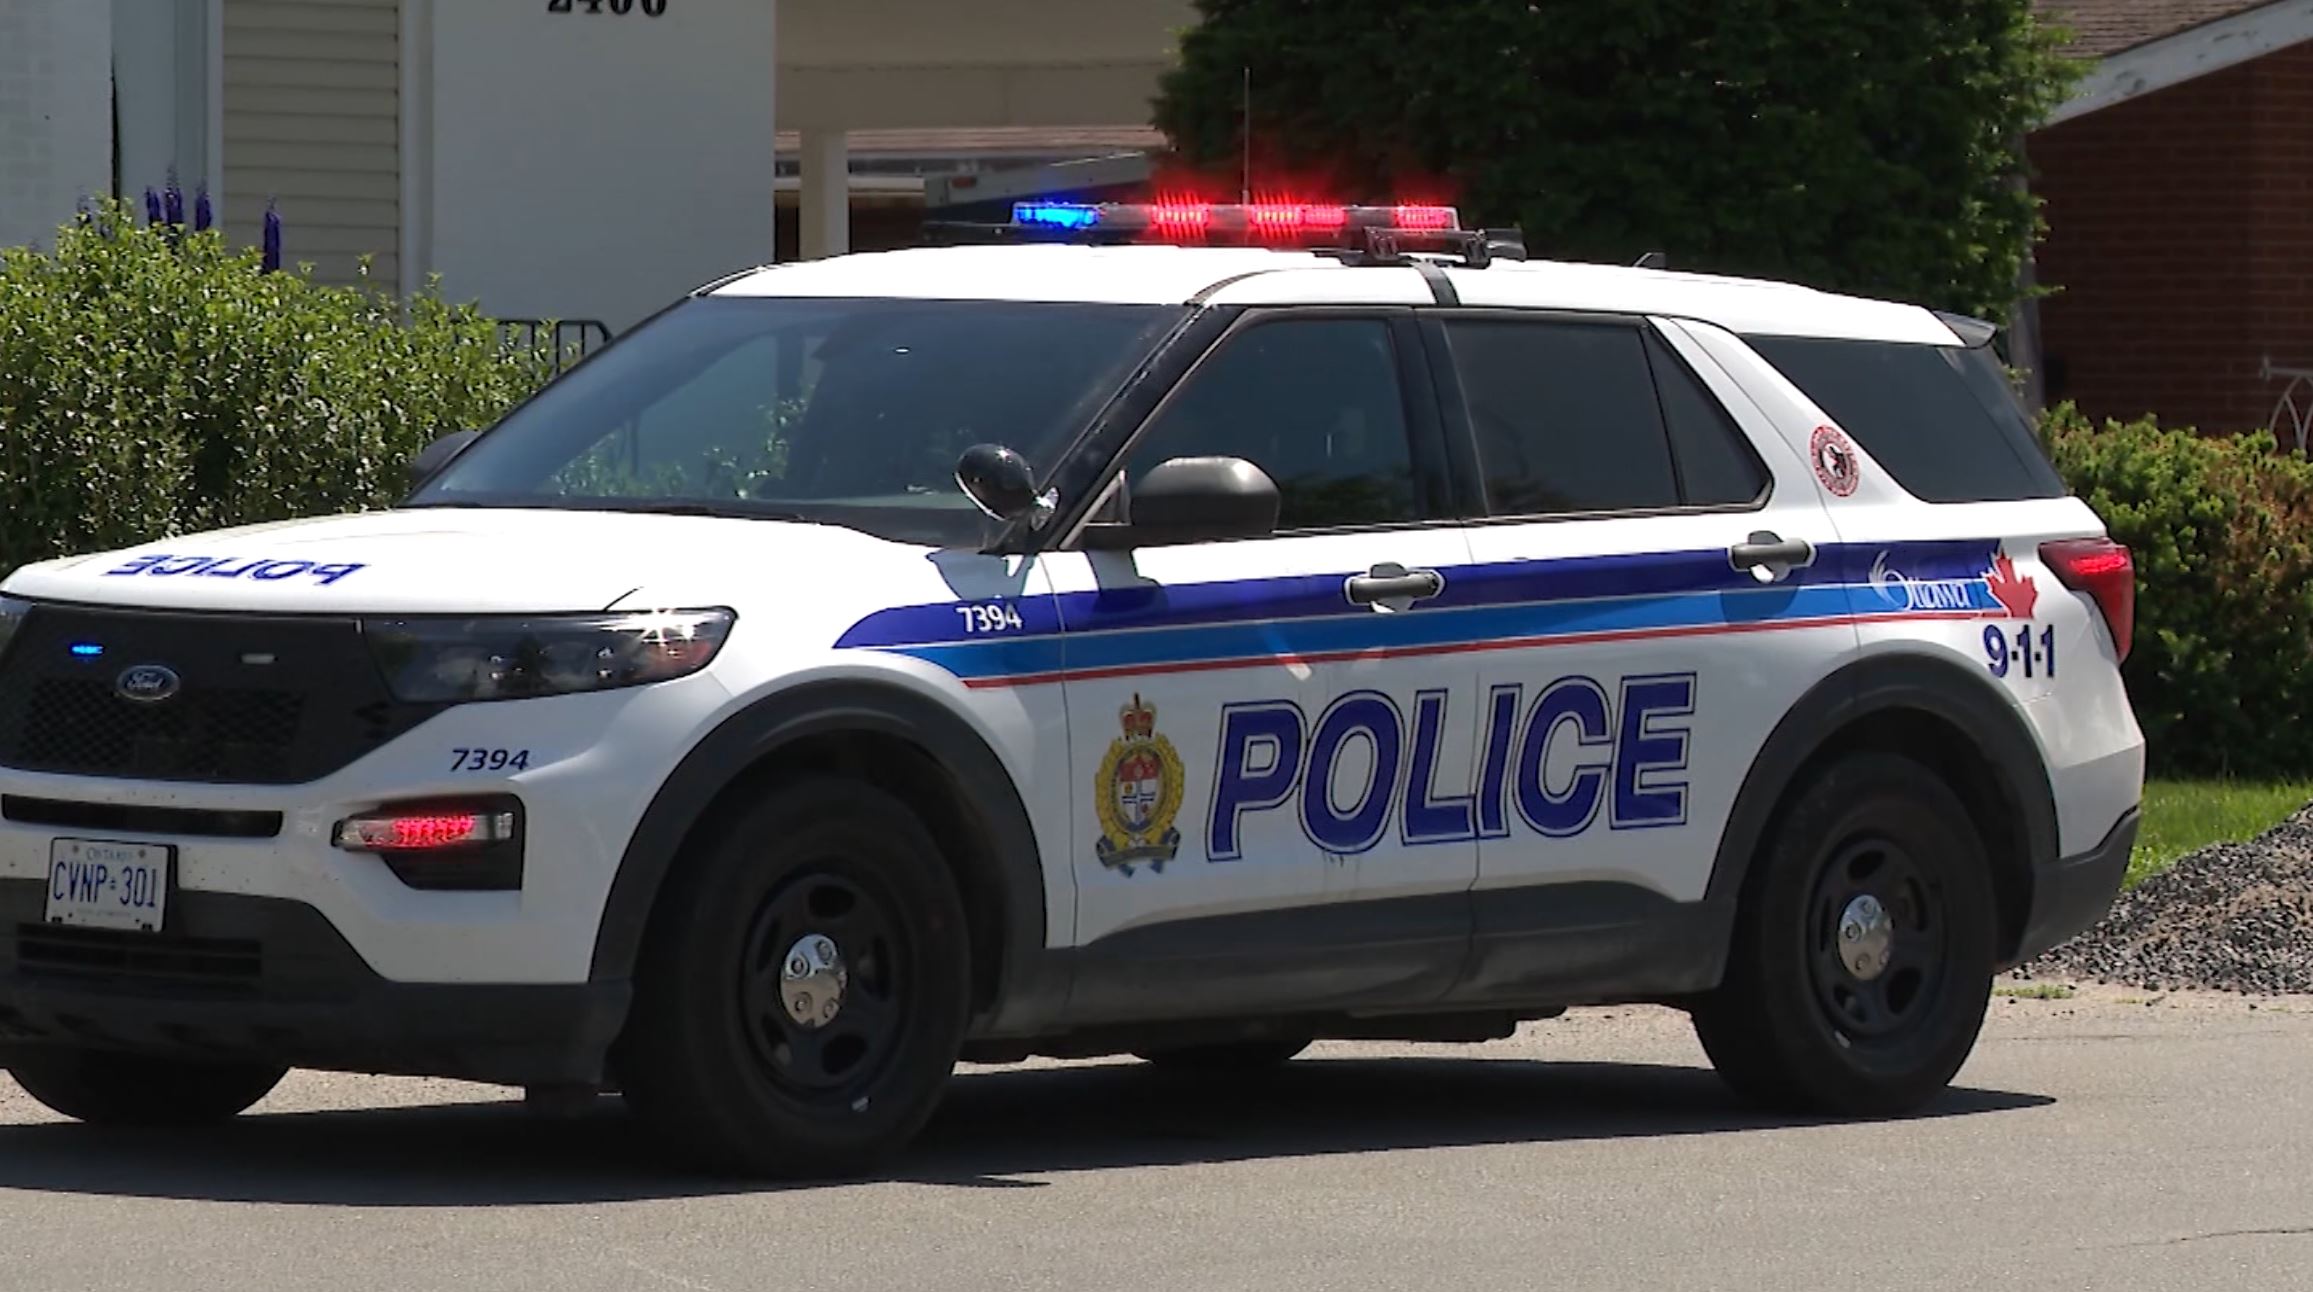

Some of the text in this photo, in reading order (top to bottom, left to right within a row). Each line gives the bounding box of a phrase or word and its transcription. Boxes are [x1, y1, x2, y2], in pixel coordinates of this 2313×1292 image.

[1869, 550, 1971, 610] Ottawa
[955, 603, 1023, 632] 7394
[449, 748, 530, 772] 7394
[1205, 672, 1697, 862] POLICE
